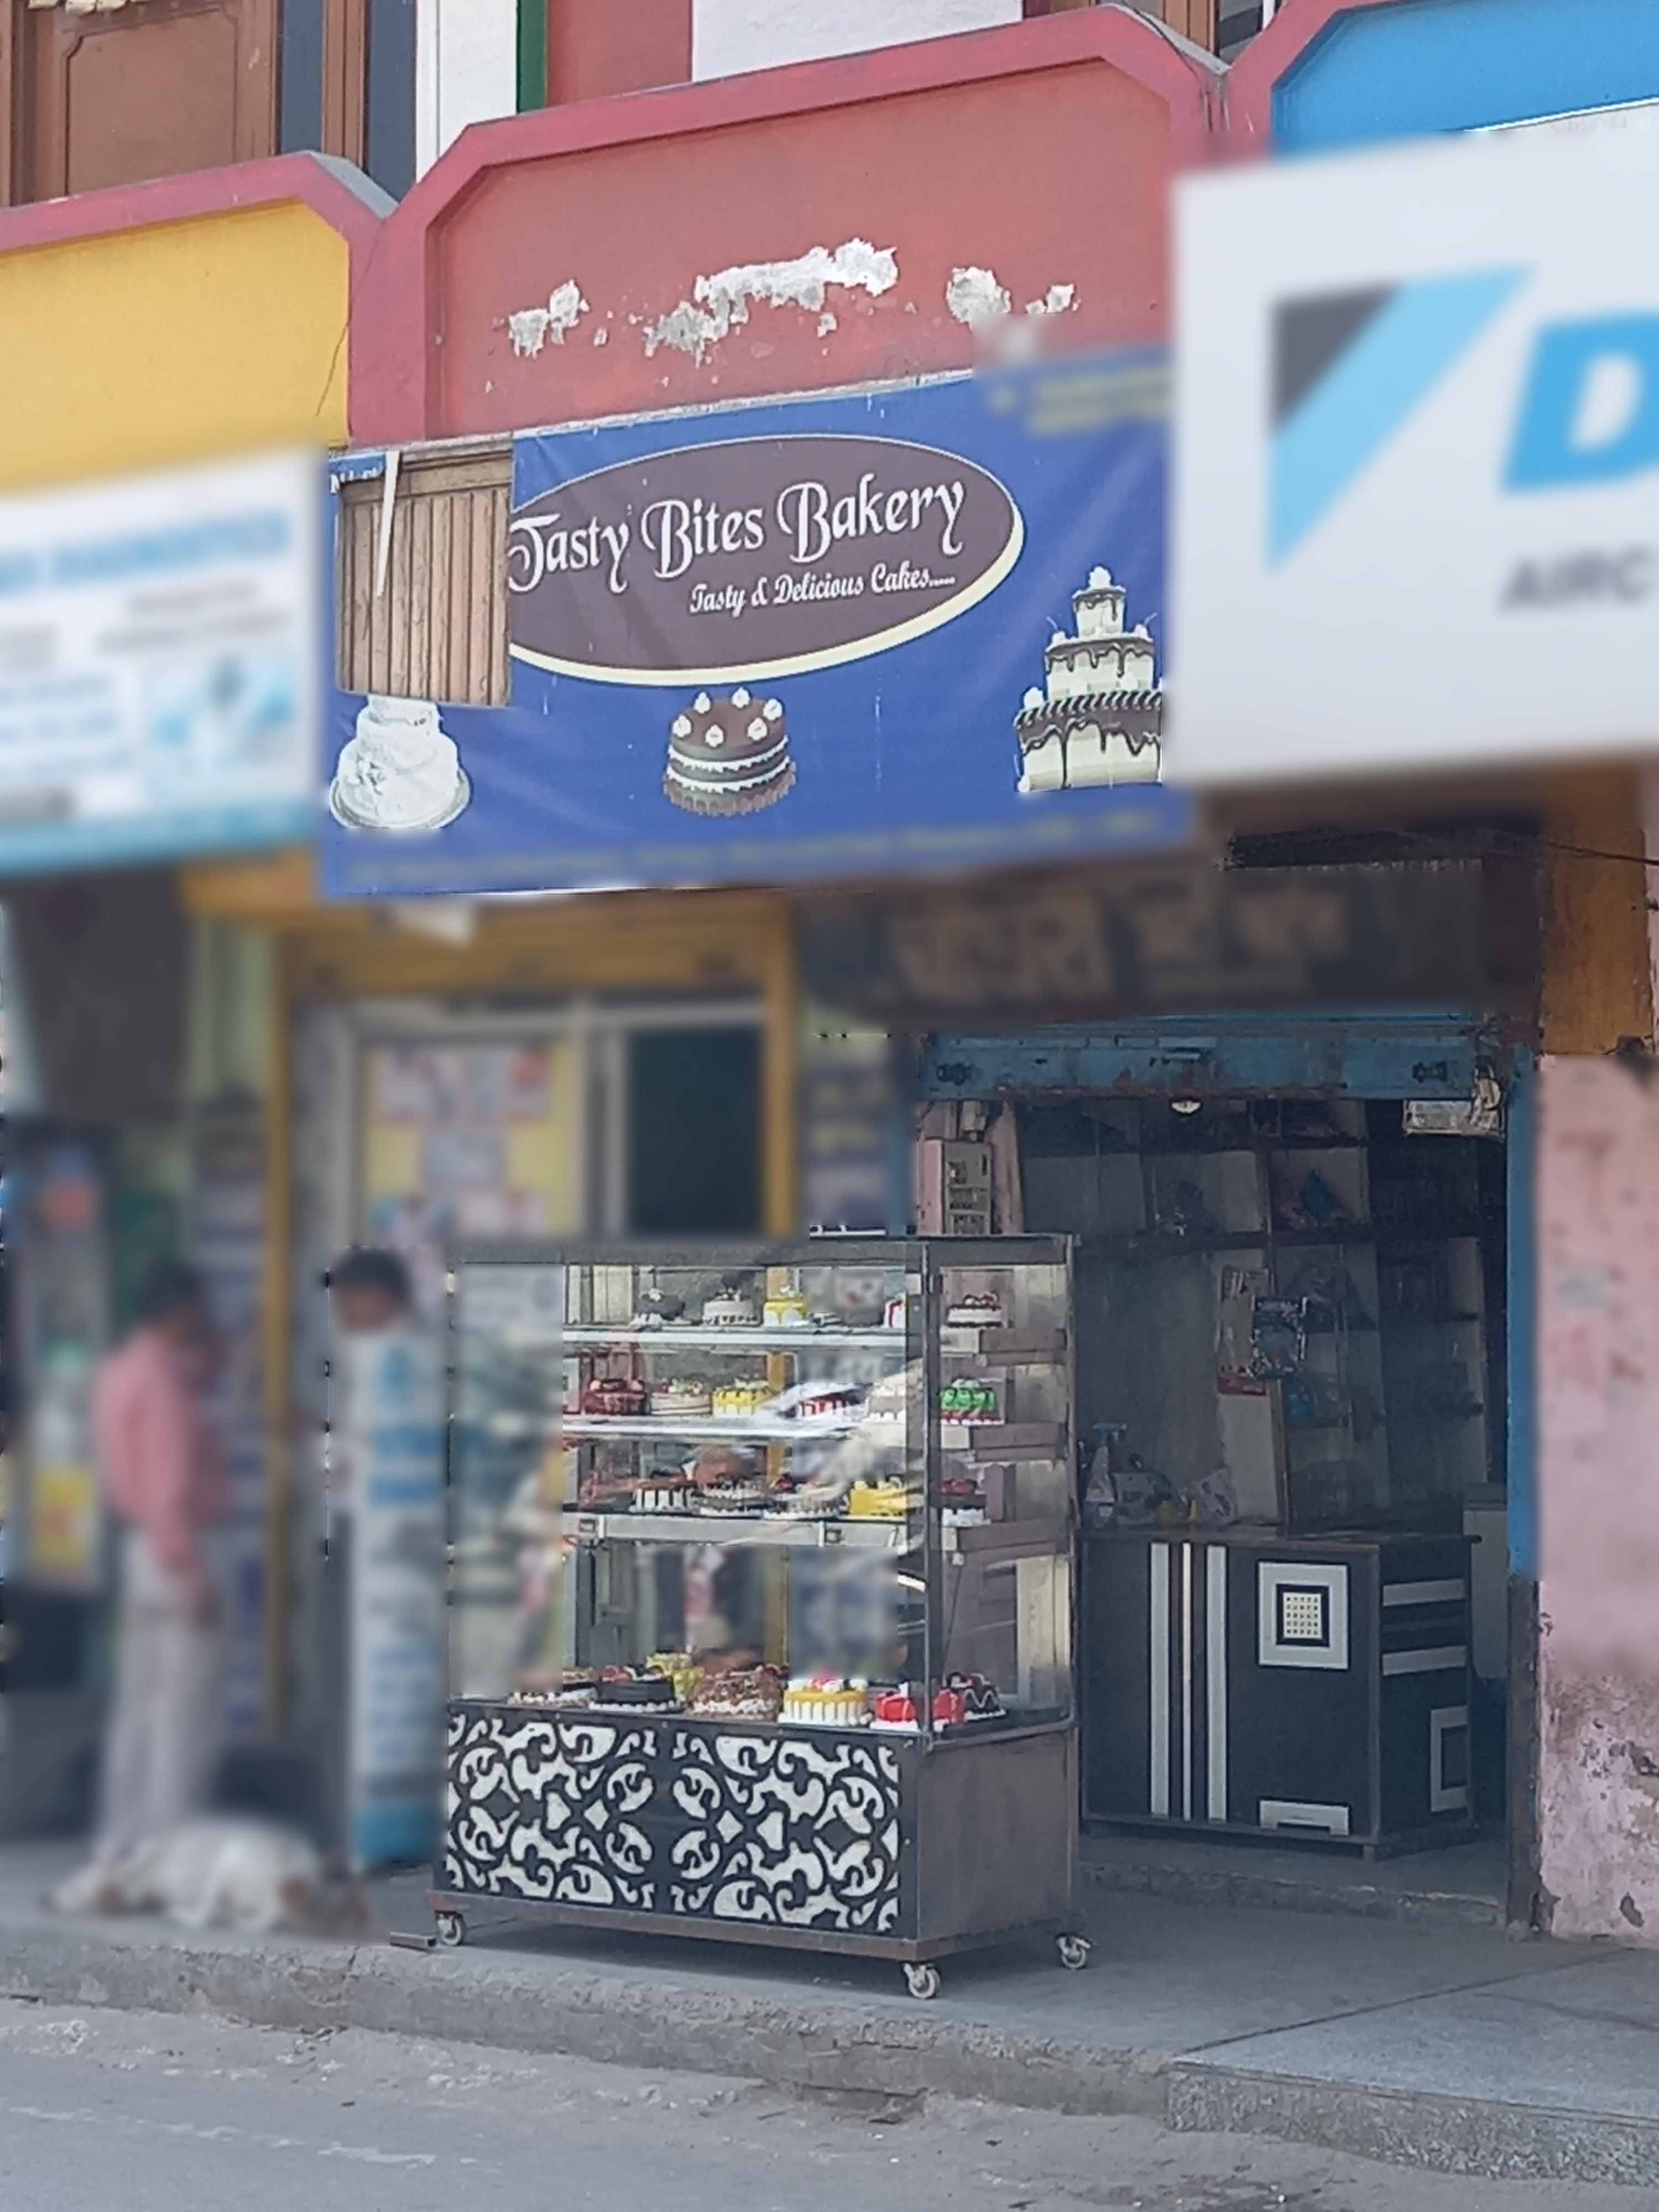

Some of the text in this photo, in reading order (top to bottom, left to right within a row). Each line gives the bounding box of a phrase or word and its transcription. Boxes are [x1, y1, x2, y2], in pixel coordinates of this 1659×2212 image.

[508, 472, 964, 593] Tasty Bites Bakery
[690, 583, 747, 617] Tasty
[750, 576, 769, 606] &
[774, 571, 864, 604] Delicious
